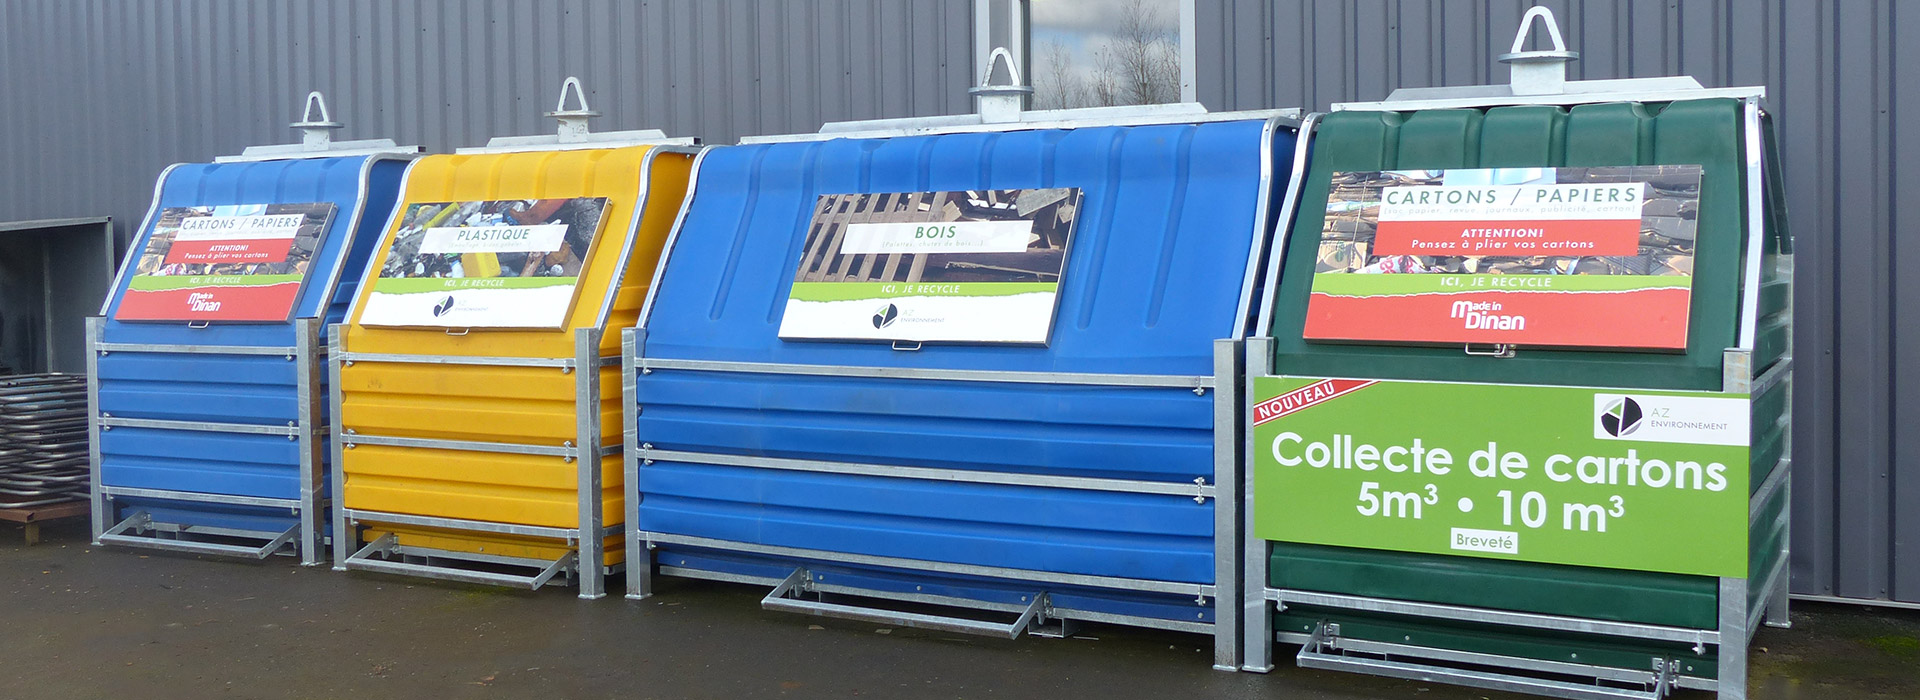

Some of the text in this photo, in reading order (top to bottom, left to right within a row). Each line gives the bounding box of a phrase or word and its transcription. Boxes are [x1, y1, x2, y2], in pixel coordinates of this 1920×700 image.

[1386, 187, 1636, 206] CARTONS / PAPIERS
[182, 219, 235, 230] CARTONS
[250, 217, 299, 228] PAPIERS
[457, 228, 531, 241] PLASTIQUE
[915, 225, 957, 239] BOIS
[1460, 228, 1544, 239] ATTENTION!
[209, 244, 249, 252] ATTENTION!
[1411, 239, 1595, 251] Pensez à plier vos cartons
[213, 251, 230, 260] plier
[189, 276, 242, 285] ICI, JE RECYCLE
[444, 279, 505, 288] ICI, JE RECYCLE
[1440, 277, 1553, 288] ICI, JE RECYCLE
[881, 284, 961, 294] ICI, JE RECYCLE
[191, 298, 222, 312] Dinan
[1450, 300, 1502, 319] Made in
[1464, 310, 1525, 331] Dinan
[1258, 381, 1335, 419] NOUVEAU
[1650, 407, 1670, 418] AZ
[1650, 420, 1728, 431] ENVIRONNEMENT
[1271, 431, 1728, 492] Collecte de cartons
[1496, 489, 1547, 529] 10
[1456, 533, 1513, 549] Breveté
